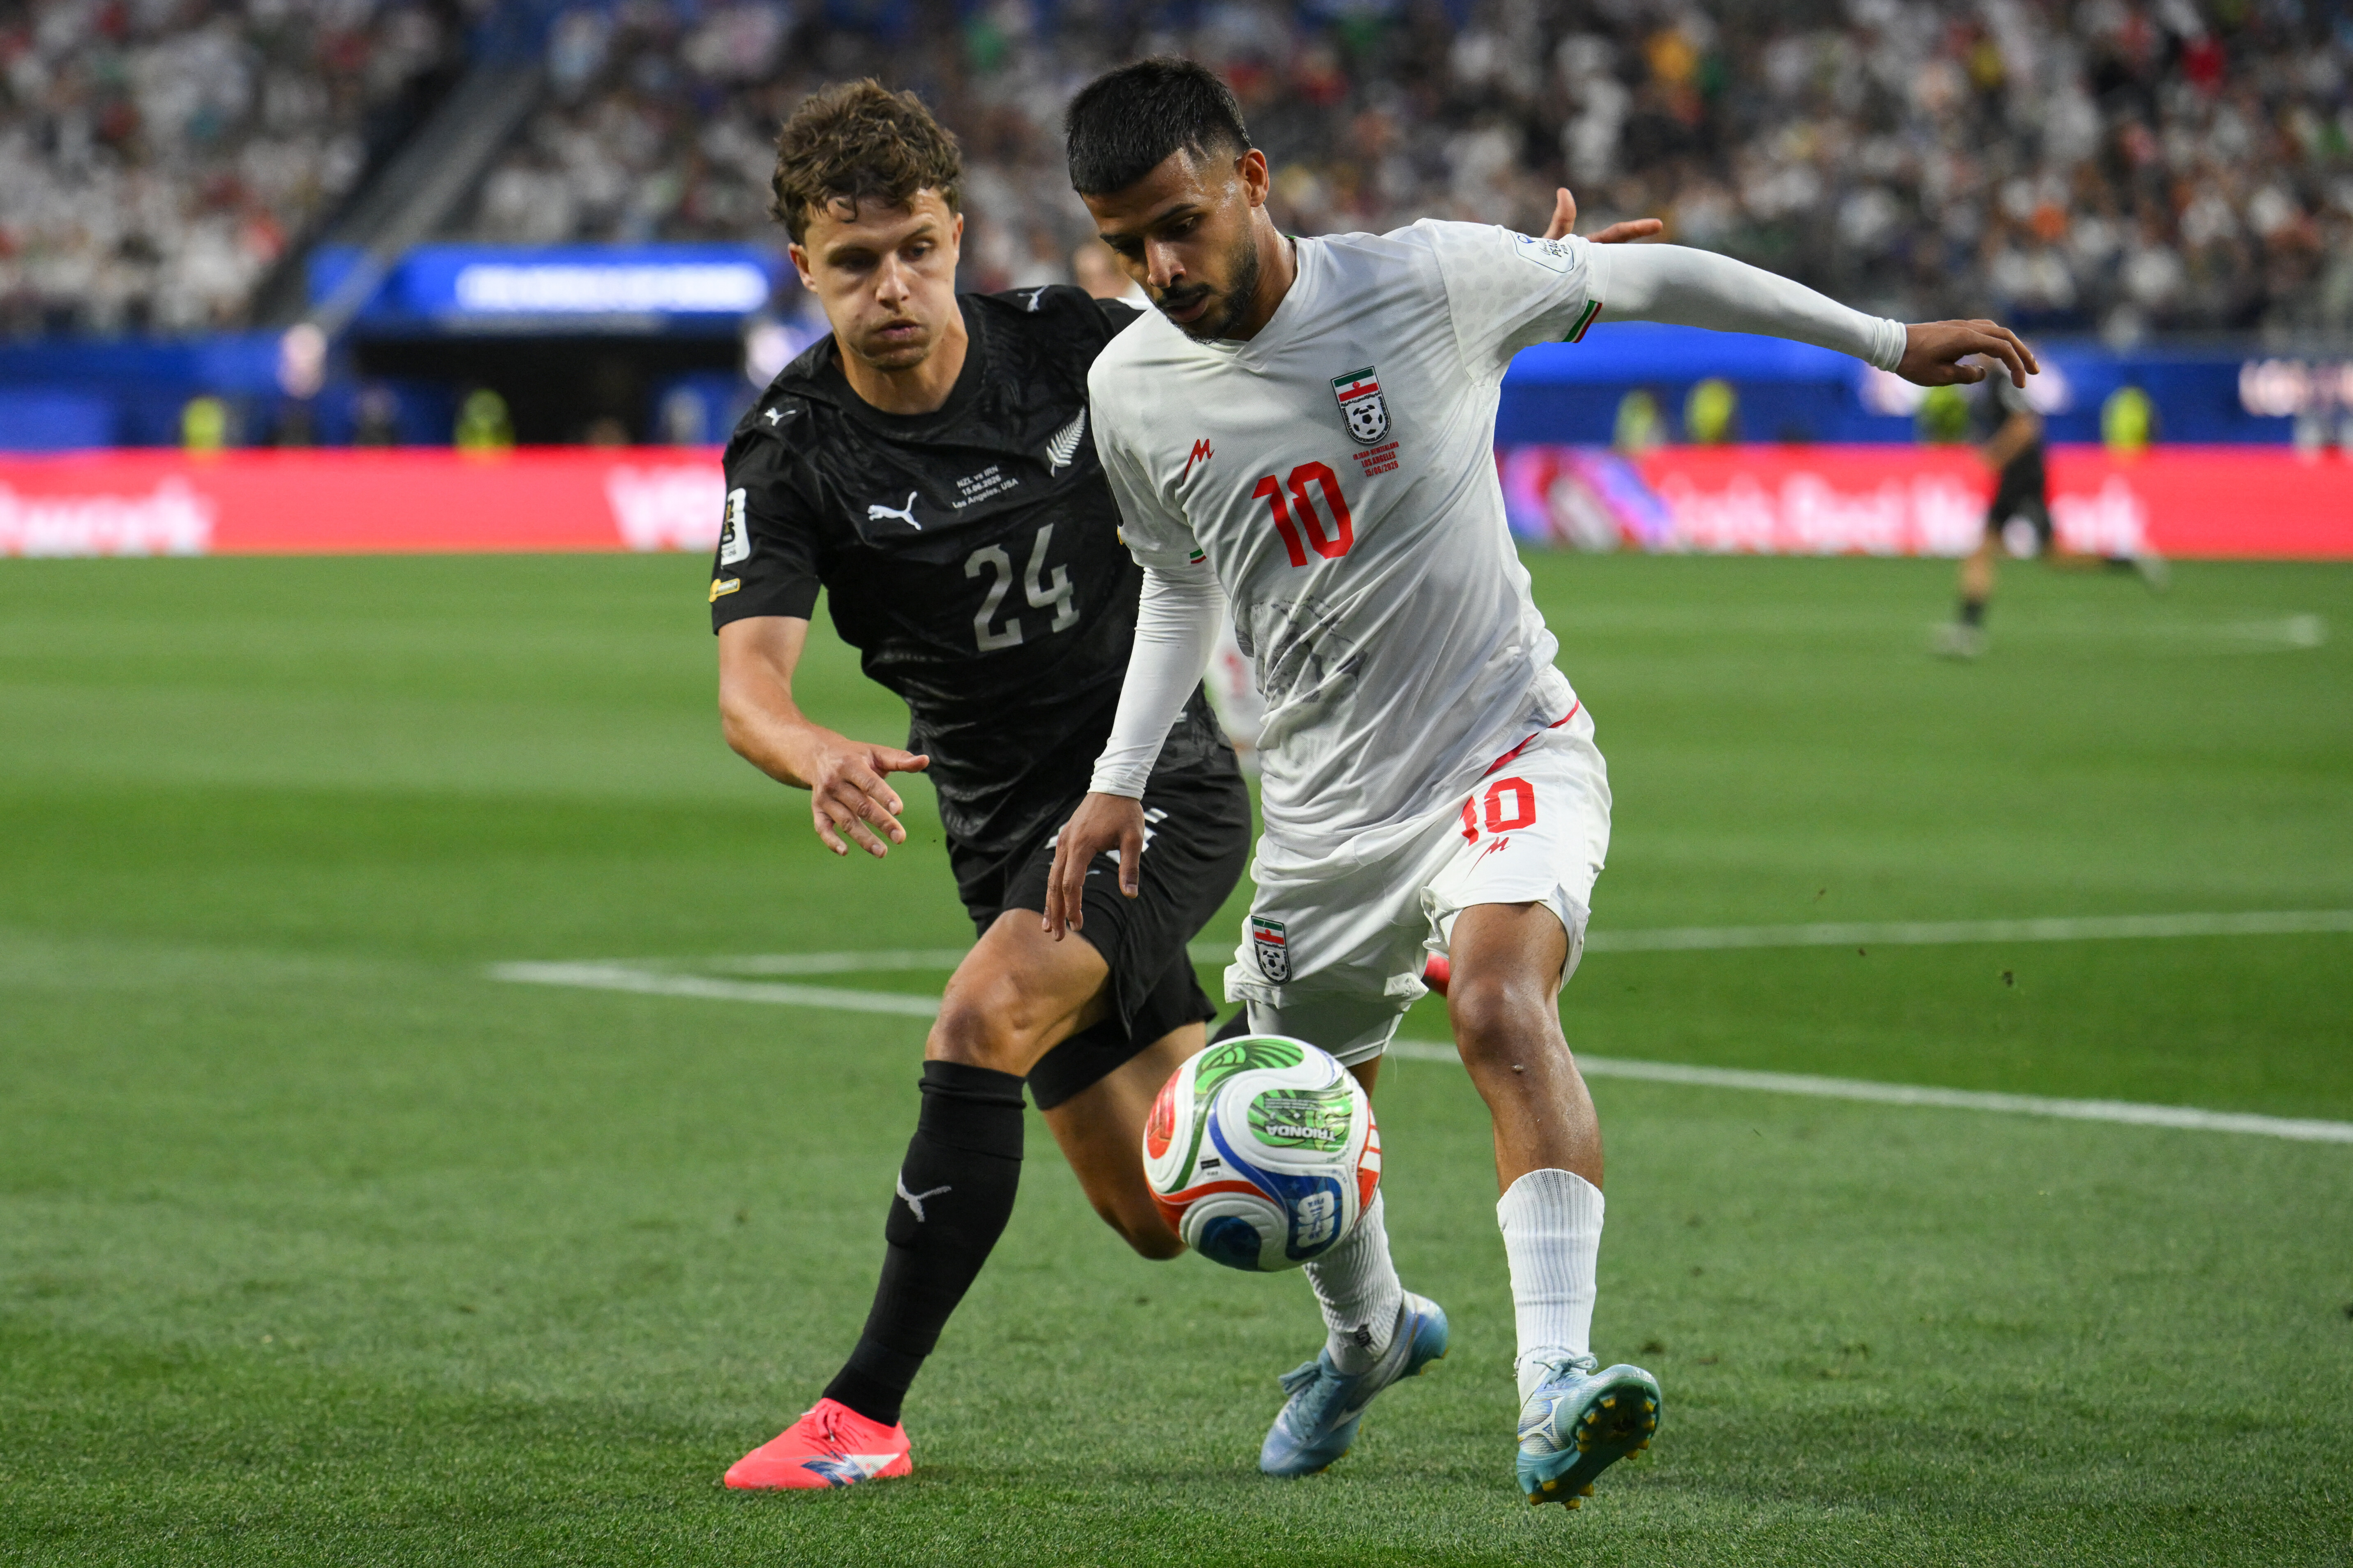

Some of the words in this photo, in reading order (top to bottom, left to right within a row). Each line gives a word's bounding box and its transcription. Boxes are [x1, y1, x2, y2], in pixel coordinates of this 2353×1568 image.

[1547, 240, 1561, 257] PEAC
[1361, 459, 1372, 468] LOS
[1372, 451, 1396, 464] ANGELES
[1365, 460, 1399, 477] 15/06/2026
[956, 477, 974, 488] NZL
[984, 465, 999, 477] IRN
[962, 474, 1001, 496] 15.06.2026
[1000, 478, 1019, 490] USA
[1252, 461, 1353, 567] 10
[964, 523, 1080, 652] 24
[1459, 777, 1536, 847] 10
[1265, 1125, 1336, 1142] TRIONDA
